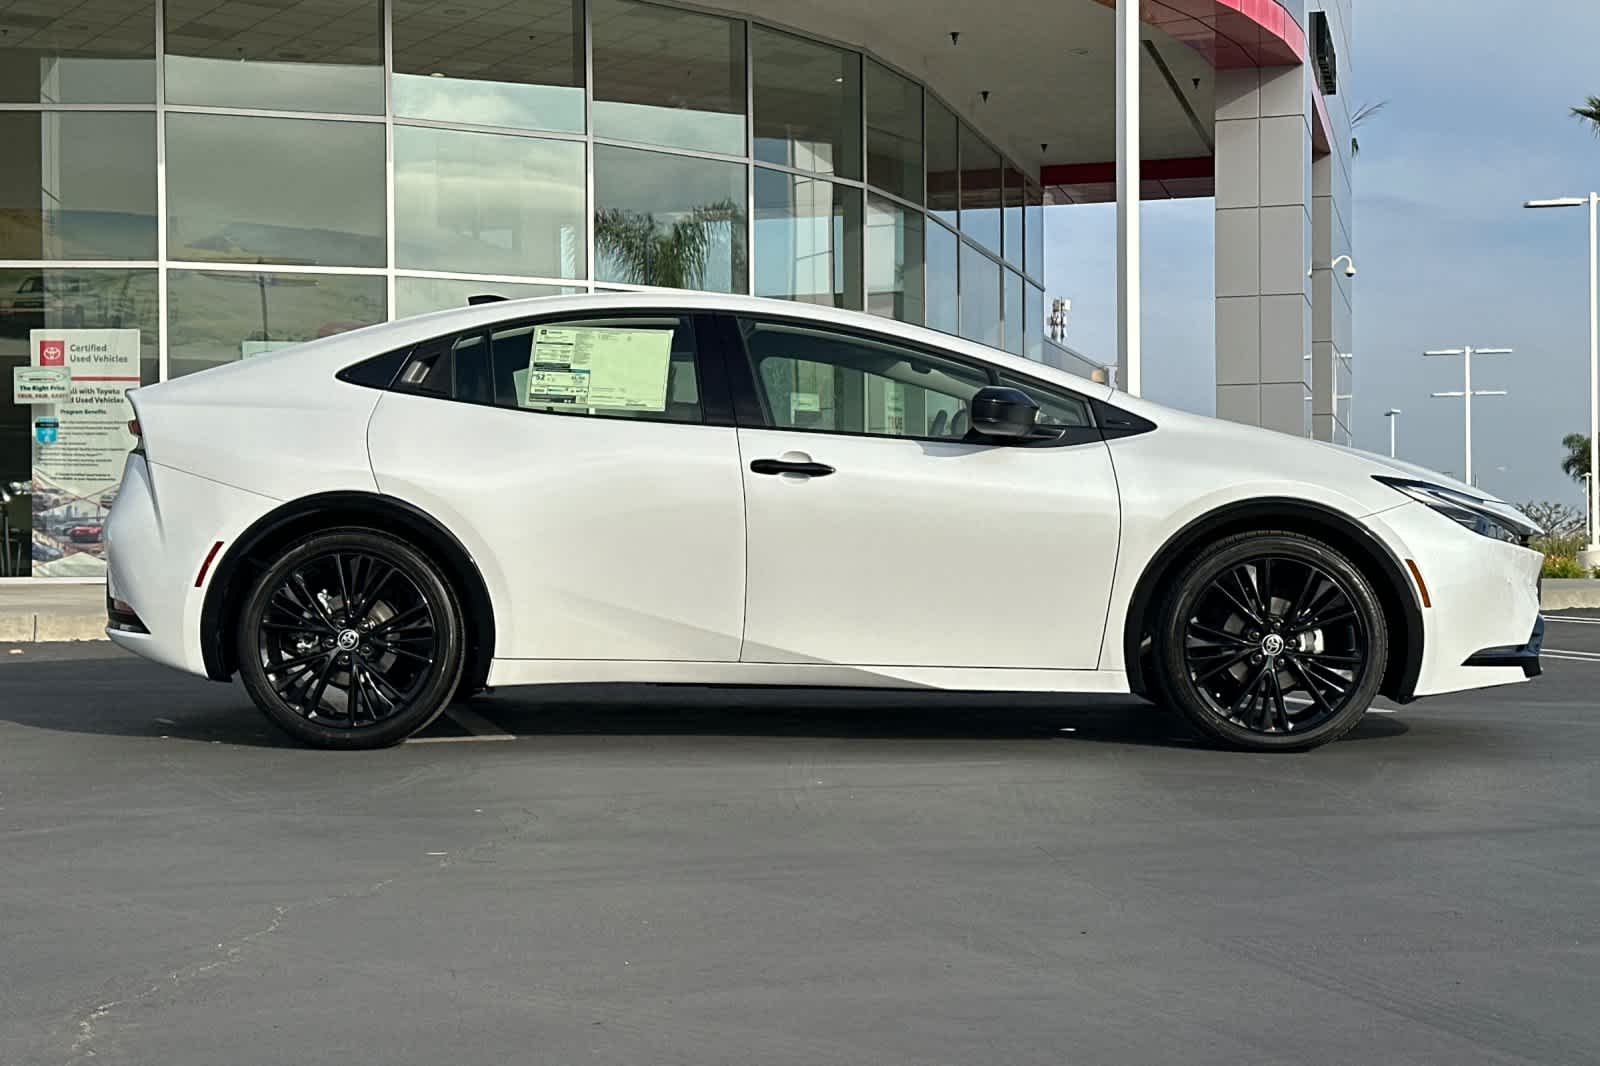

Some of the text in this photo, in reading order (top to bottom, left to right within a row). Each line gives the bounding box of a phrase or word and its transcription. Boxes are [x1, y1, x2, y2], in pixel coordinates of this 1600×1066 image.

[70, 344, 107, 352] Certified
[70, 355, 128, 363] Used Vehicles
[96, 388, 120, 396] Toyota
